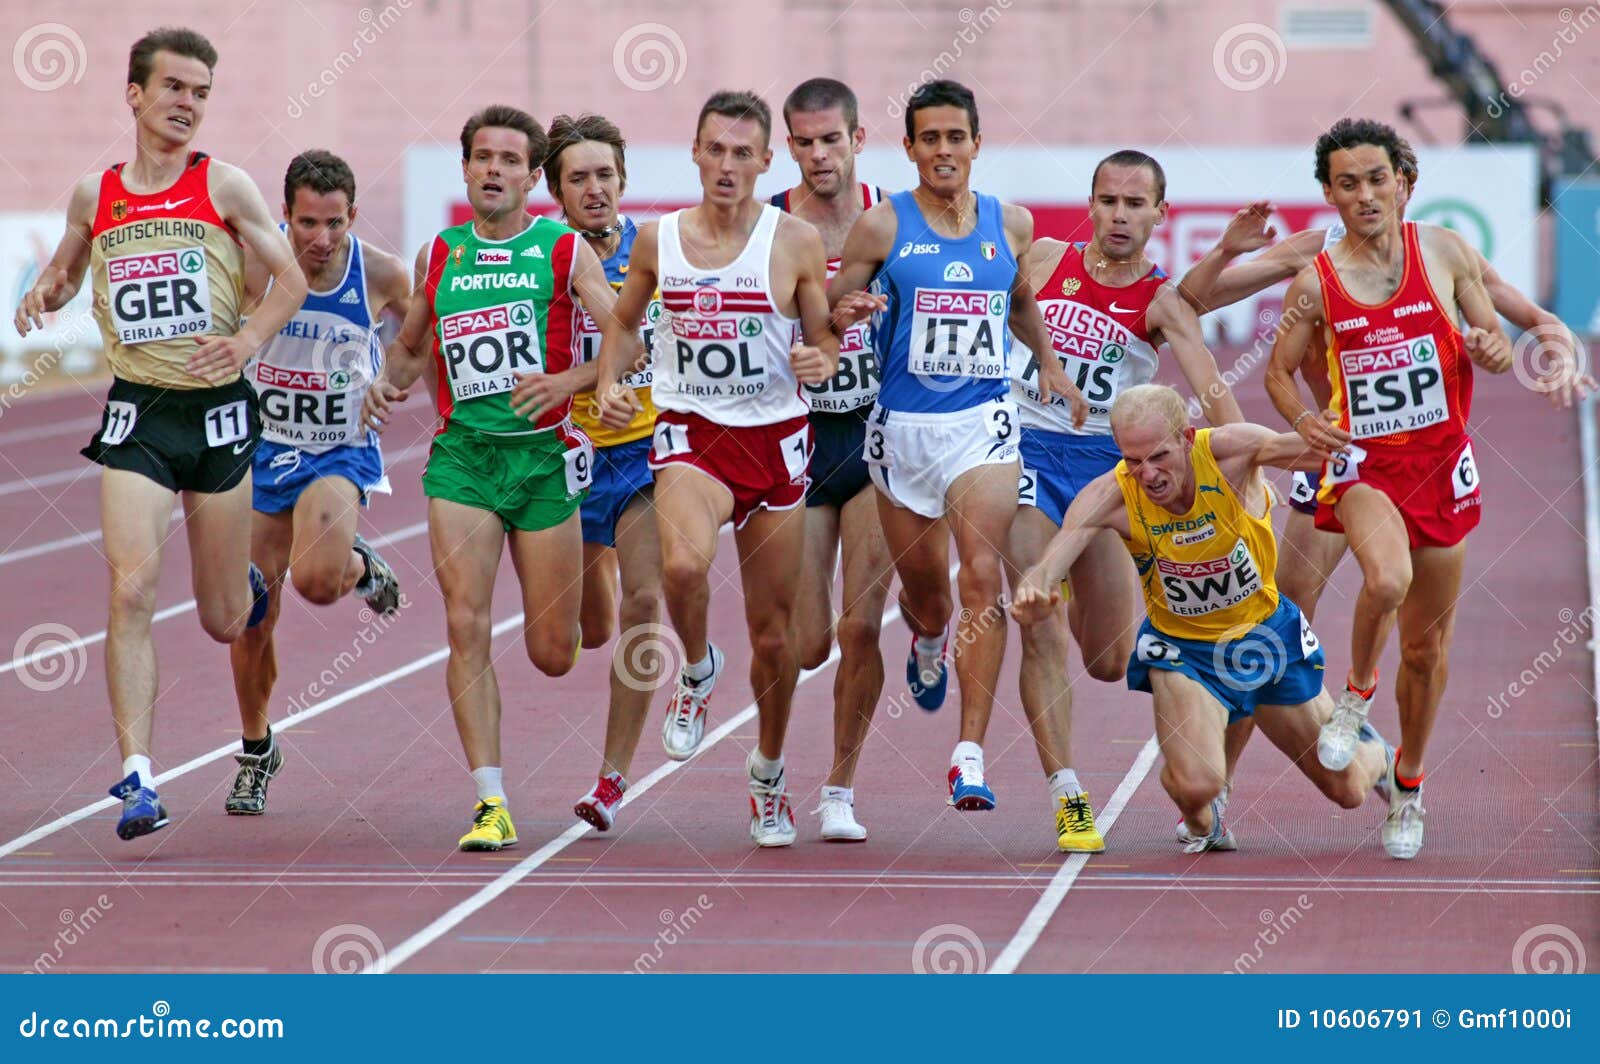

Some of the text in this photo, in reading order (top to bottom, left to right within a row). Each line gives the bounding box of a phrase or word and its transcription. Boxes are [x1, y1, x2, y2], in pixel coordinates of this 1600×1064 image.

[100, 220, 205, 251] DEUTSCHLAND
[913, 244, 940, 254] asics
[109, 256, 178, 280] SPAR
[451, 273, 539, 291] PORTUGAL
[736, 277, 760, 287] POL
[114, 278, 205, 322] GER
[917, 293, 986, 315] SPAR
[1393, 301, 1433, 318] ESPAÑA
[169, 319, 207, 336] 2009
[280, 320, 350, 344] HELLAS
[444, 310, 508, 337] SPAR
[672, 320, 736, 338] SPAR
[924, 317, 996, 356] ITA
[445, 331, 538, 380] POR
[1050, 331, 1100, 358] PAR
[676, 340, 764, 379] POL
[914, 361, 1000, 376] LEIRIA 2009
[1343, 350, 1411, 374] SPAR
[258, 365, 327, 390] SPAR
[457, 379, 498, 398] LEIRIA
[678, 382, 764, 396] LEIRIA 2009
[811, 398, 848, 410] EIRIA
[1349, 368, 1439, 417] ESP
[260, 389, 347, 425] GRE
[110, 407, 131, 438] 11
[208, 406, 242, 439] 11
[264, 422, 346, 441] EIRIA 2009
[993, 409, 1012, 439] 3
[1354, 408, 1443, 437] LEIRIA 2009
[660, 425, 674, 451] 1
[793, 436, 805, 466] 1
[869, 430, 884, 460] 3
[575, 451, 588, 482] 9
[1459, 456, 1474, 487] 6
[1018, 475, 1034, 500] 2
[1151, 511, 1217, 536] SWEDEN
[1158, 558, 1229, 577] SPAR
[1163, 558, 1257, 603] SWE
[1172, 583, 1258, 616] LEIRIA 2009
